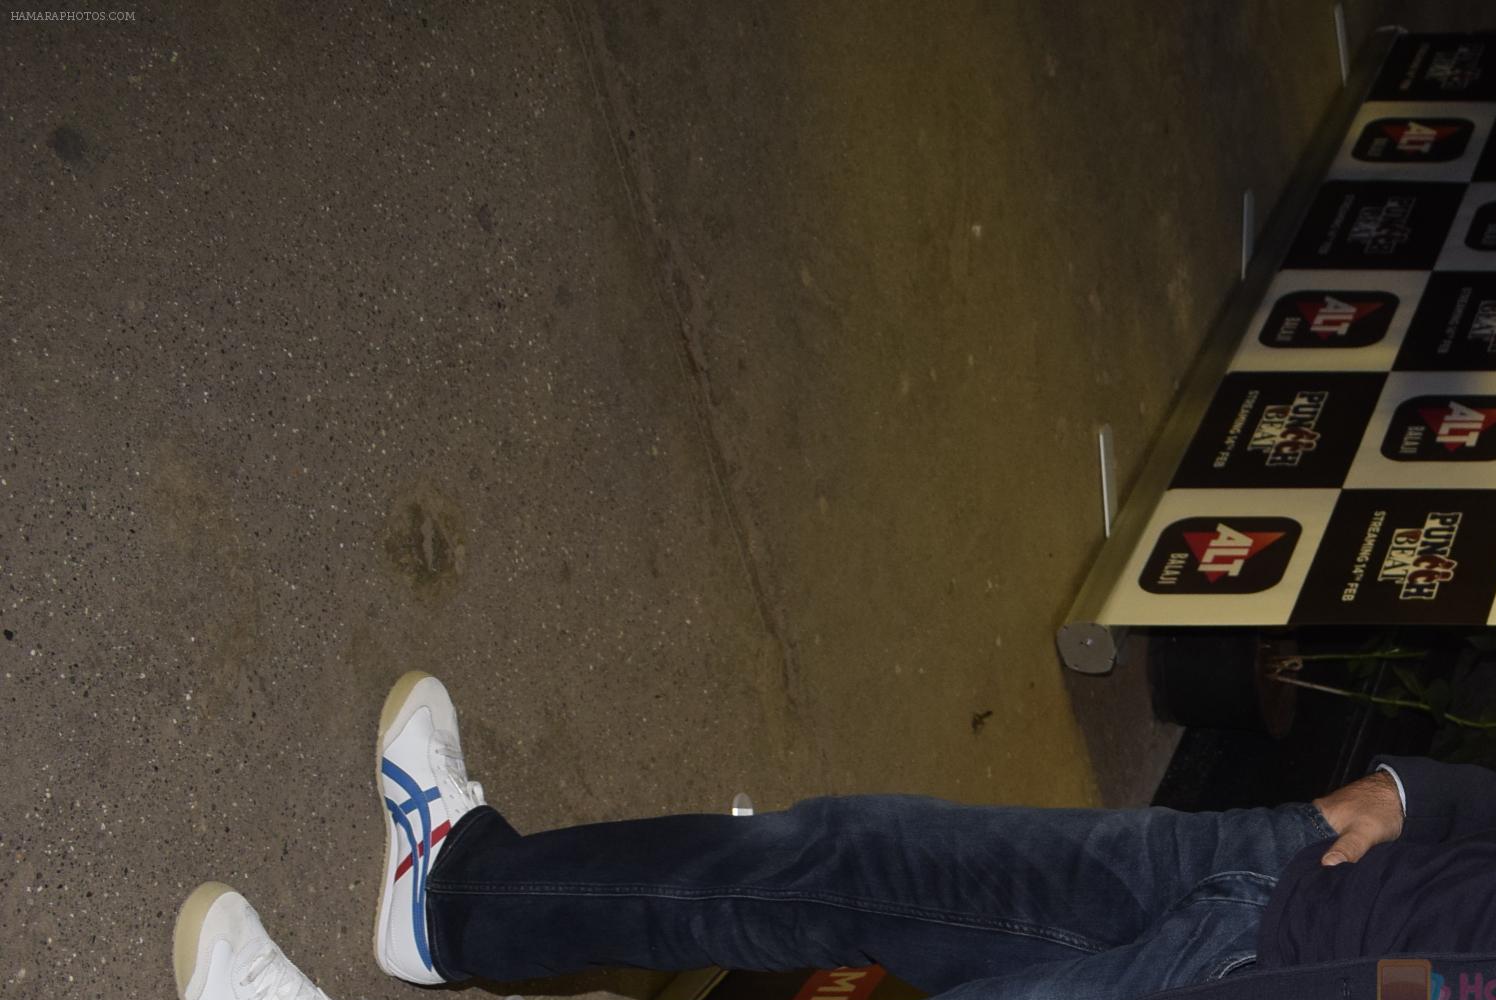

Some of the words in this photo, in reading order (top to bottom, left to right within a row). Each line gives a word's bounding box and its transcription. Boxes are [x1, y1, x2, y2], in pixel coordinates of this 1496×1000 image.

[1395, 121, 1438, 152] ALT
[1308, 296, 1357, 334] ALT
[1245, 406, 1290, 451] BEAT
[1433, 401, 1485, 446] ALT
[1195, 523, 1254, 576] ALT
[1354, 511, 1387, 562] STREAMING
[1376, 529, 1421, 581] BEAT
[1339, 582, 1359, 601] FEB
